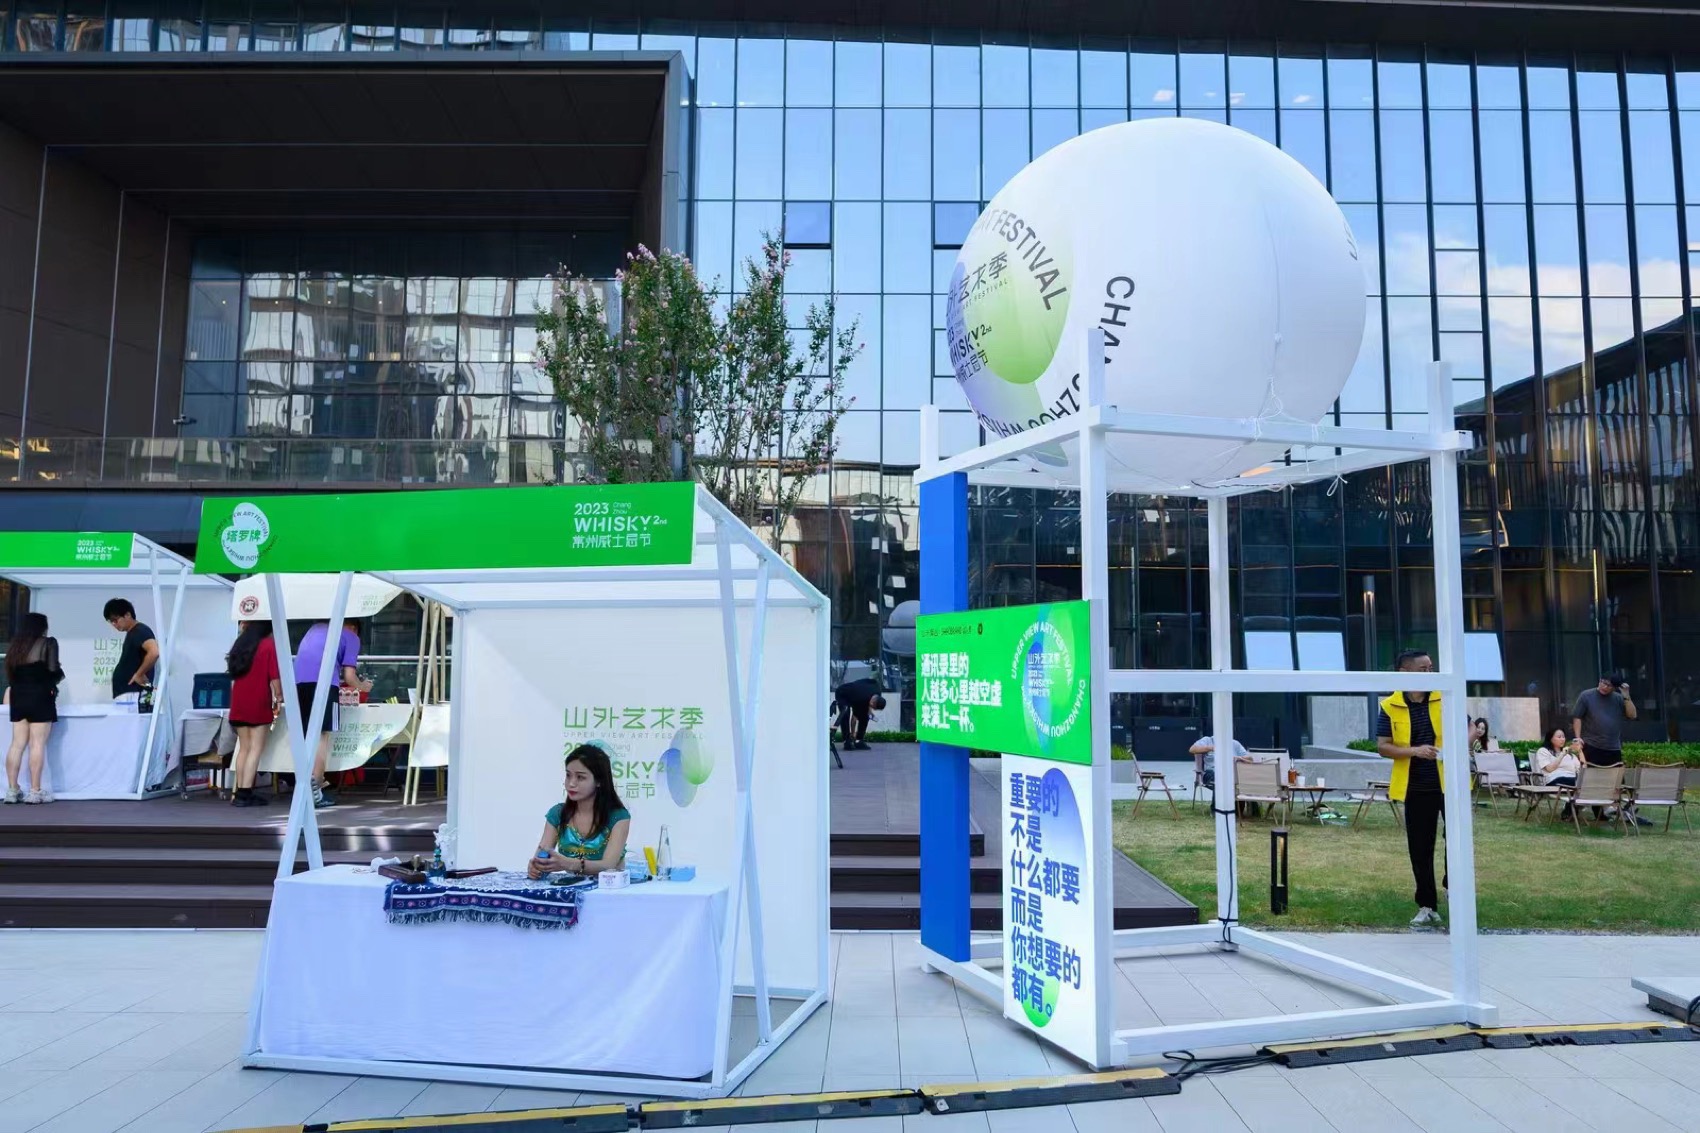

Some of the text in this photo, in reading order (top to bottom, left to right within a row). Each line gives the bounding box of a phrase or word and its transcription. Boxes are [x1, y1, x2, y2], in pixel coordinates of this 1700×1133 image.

[992, 208, 1067, 311] FESTIVAL
[573, 502, 610, 516] 2023
[574, 516, 652, 532] WHISKY
[226, 529, 261, 543] 塔罗牌
[572, 533, 651, 548] 常州威士忌节
[564, 706, 703, 730] 山外艺术季
[1009, 772, 1060, 818] 重要的
[1010, 812, 1043, 854] 不是
[1010, 848, 1081, 905] 什么都要
[1010, 887, 1044, 934] 而是
[1010, 926, 1082, 991] 你想要的
[1011, 966, 1054, 1019] 都有。
